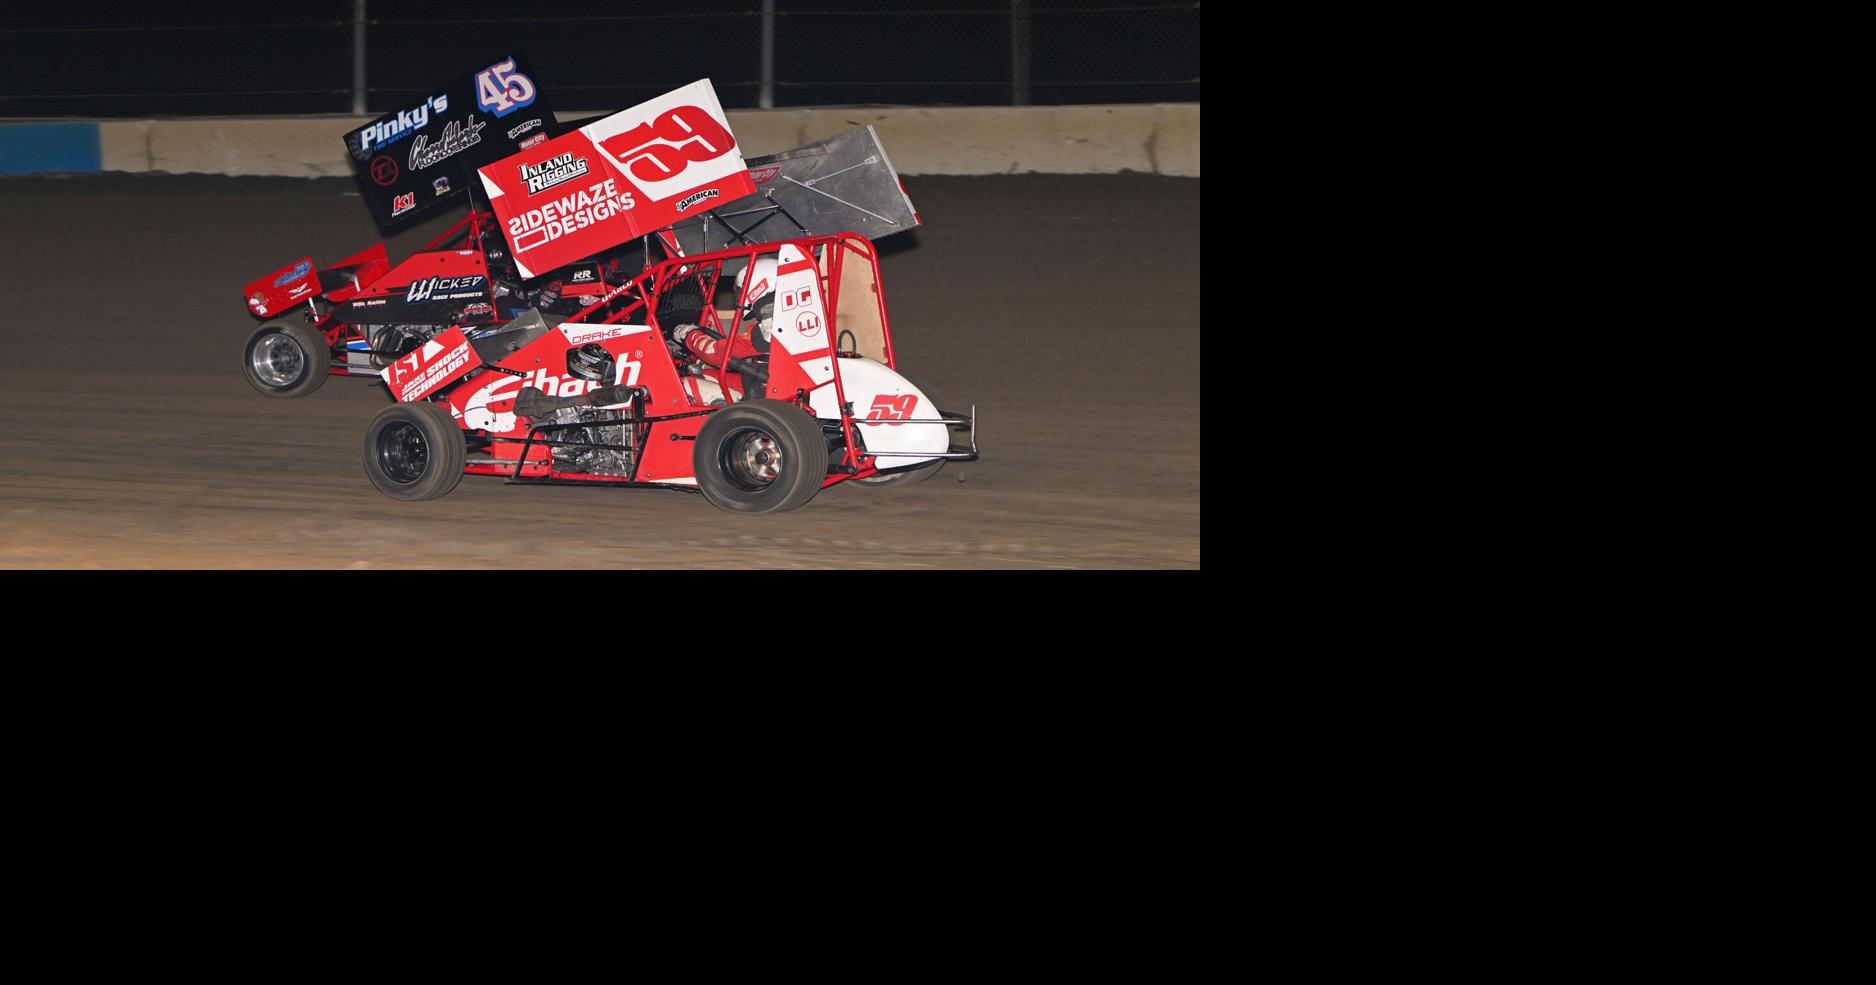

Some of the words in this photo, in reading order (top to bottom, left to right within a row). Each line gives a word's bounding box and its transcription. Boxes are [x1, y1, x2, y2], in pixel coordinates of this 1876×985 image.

[476, 57, 536, 116] 45
[361, 94, 448, 151] Pinky's
[511, 119, 541, 138] AMERICAN
[598, 105, 736, 182] 59
[520, 152, 573, 181] INLAND
[528, 158, 588, 194] RIGGING
[393, 192, 415, 213] K1
[508, 178, 618, 235] SIDEWAZE
[546, 192, 636, 241] DESIGNS
[679, 190, 719, 210] AMERICAN
[407, 276, 483, 302] WICKED
[574, 269, 592, 279] RR
[572, 328, 622, 344] DRAKE
[402, 350, 470, 402] TECHNOLOGY
[426, 340, 469, 378] SHOCK
[866, 394, 918, 427] 59
